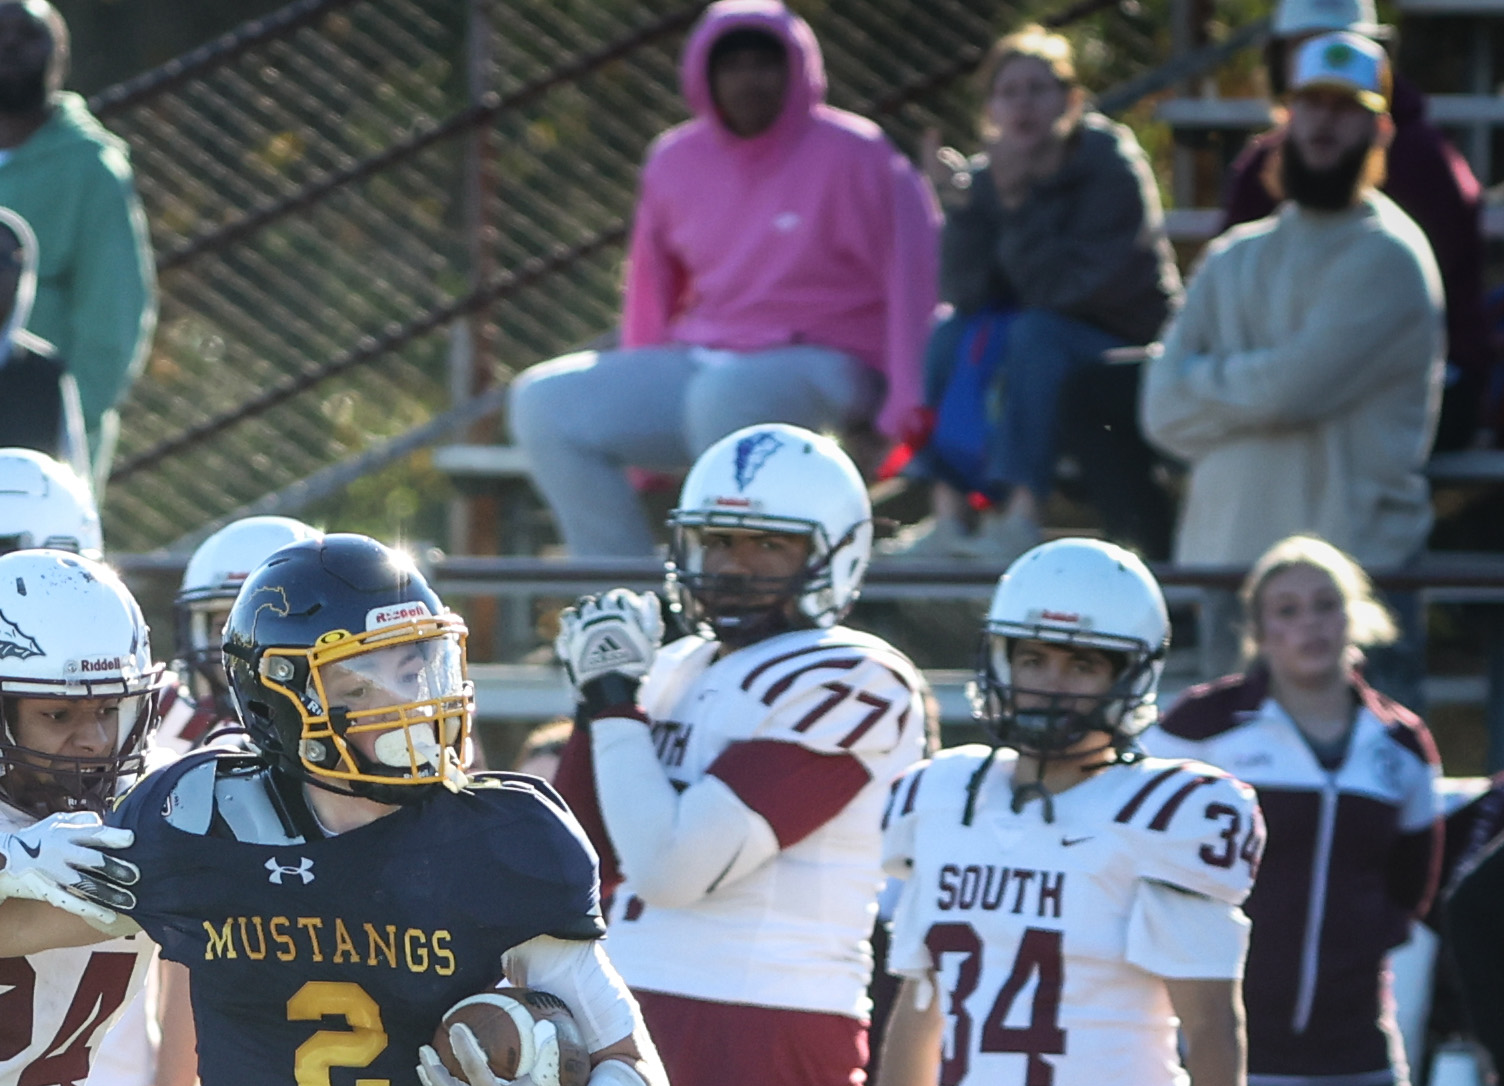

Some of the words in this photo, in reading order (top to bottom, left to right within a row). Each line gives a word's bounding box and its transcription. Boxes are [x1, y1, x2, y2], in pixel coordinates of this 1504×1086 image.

[81, 657, 121, 672] Riddell
[791, 678, 891, 749] 77
[938, 864, 1066, 918] SOUTH
[202, 916, 455, 976] MUSTANGS
